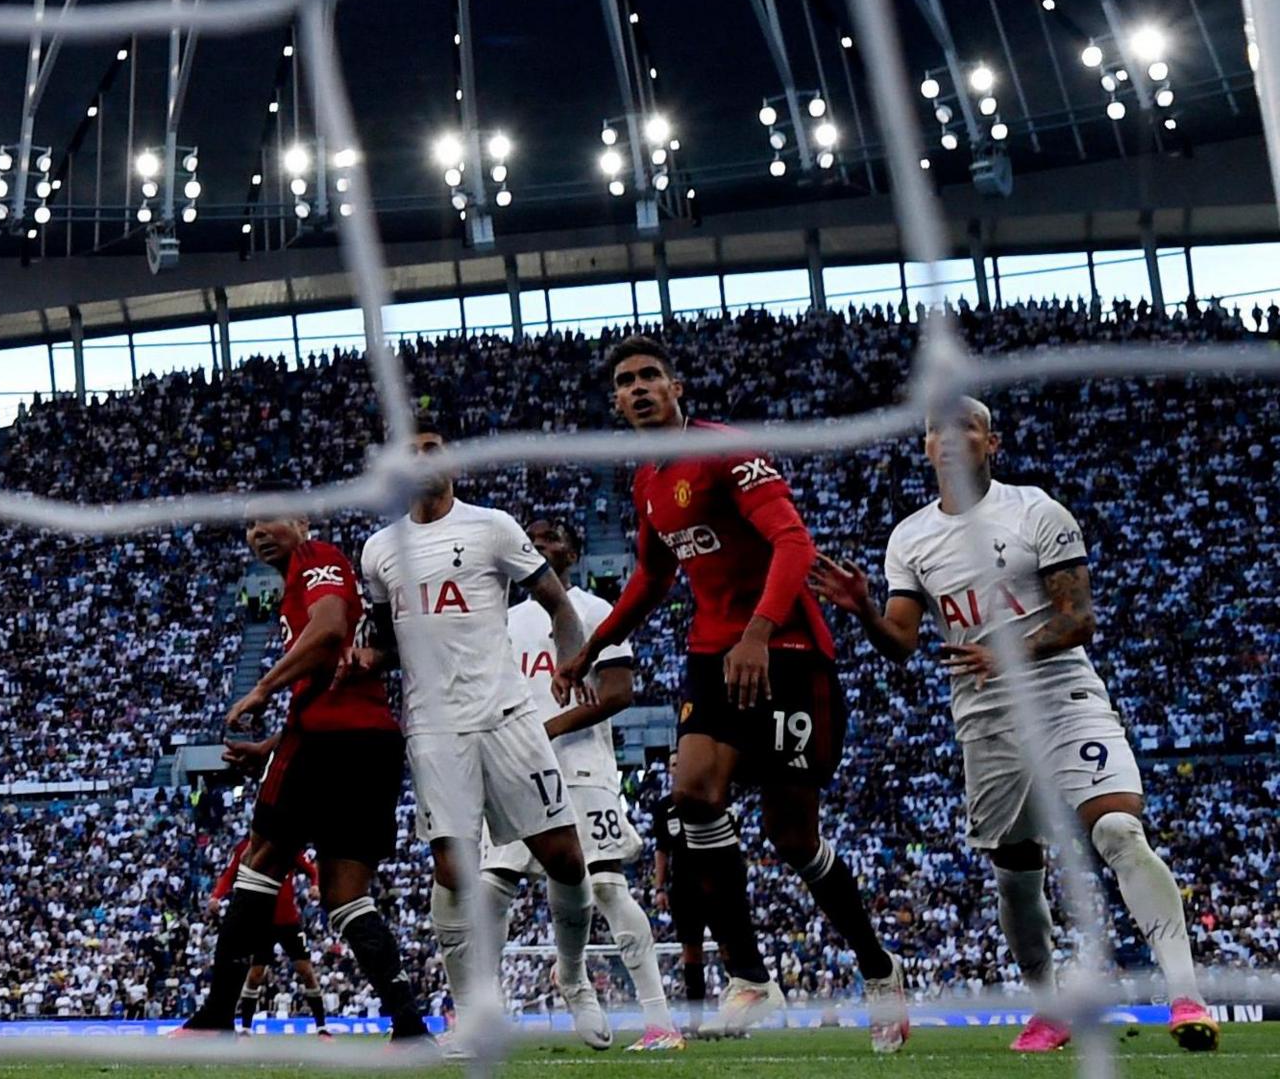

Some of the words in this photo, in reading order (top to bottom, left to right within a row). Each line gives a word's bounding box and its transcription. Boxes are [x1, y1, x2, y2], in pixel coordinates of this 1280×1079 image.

[1056, 530, 1083, 546] cin
[520, 651, 557, 679] IA
[773, 710, 812, 752] 19
[1079, 741, 1108, 771] 9
[530, 768, 562, 806] 17
[587, 809, 622, 841] 38
